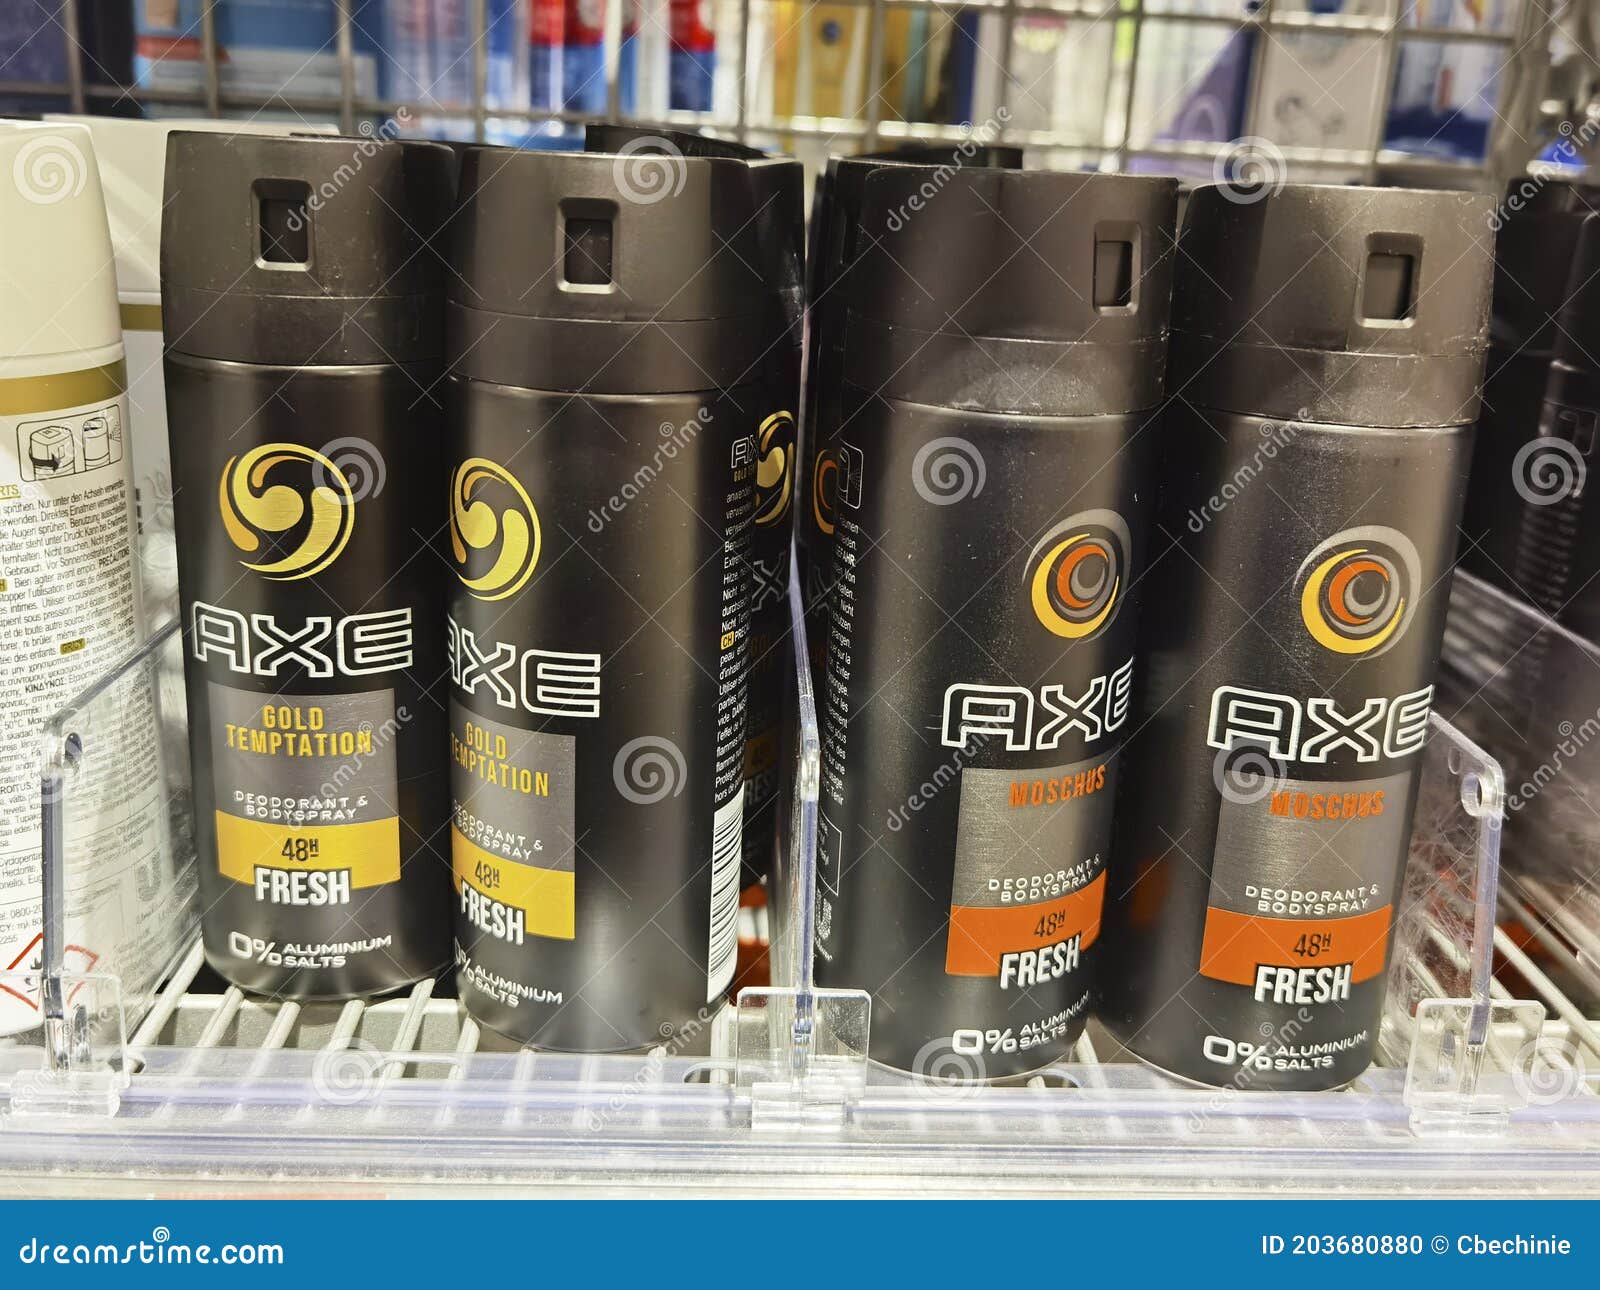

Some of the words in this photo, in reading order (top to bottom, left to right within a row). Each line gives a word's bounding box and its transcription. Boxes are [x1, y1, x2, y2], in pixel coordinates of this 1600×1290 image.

[193, 601, 412, 678] AXE
[448, 612, 600, 718] AXE
[263, 705, 324, 731] GOLD
[942, 655, 1133, 751] AXE
[226, 723, 371, 757] TEMPTATION
[466, 721, 507, 760] GOLD
[1206, 684, 1434, 763] AXE
[234, 790, 349, 810] DEODORANT
[358, 795, 369, 807] &
[1009, 764, 1106, 808] MOSCHUS
[246, 804, 357, 821] BODYSPRAY
[1269, 791, 1385, 821] MOSCHUS
[534, 839, 544, 851] &
[255, 866, 350, 906] FRESH
[988, 858, 1091, 891] DEODORANT
[1001, 869, 1093, 903] BODYSPRAY
[1245, 884, 1364, 902] DEODORANT
[1370, 883, 1379, 896] &
[1257, 898, 1368, 915] BODYSPRAY
[461, 879, 525, 945] FRESH
[228, 931, 282, 967] 0%
[281, 935, 392, 956] ALUMINIUM
[284, 955, 347, 968] SALTS
[1000, 934, 1081, 990] FRESH
[474, 964, 564, 1005] ALUMINIUM
[474, 976, 520, 1009] SALTS
[1254, 964, 1352, 1005] FRESH
[952, 1028, 1018, 1055] 0%
[1019, 990, 1089, 1036] ALUMINIUM
[1019, 1022, 1067, 1048] SALTS
[1203, 1035, 1274, 1071] 0%
[1275, 1030, 1368, 1057] ALUMINIUM
[1274, 1055, 1335, 1071] SALTS
